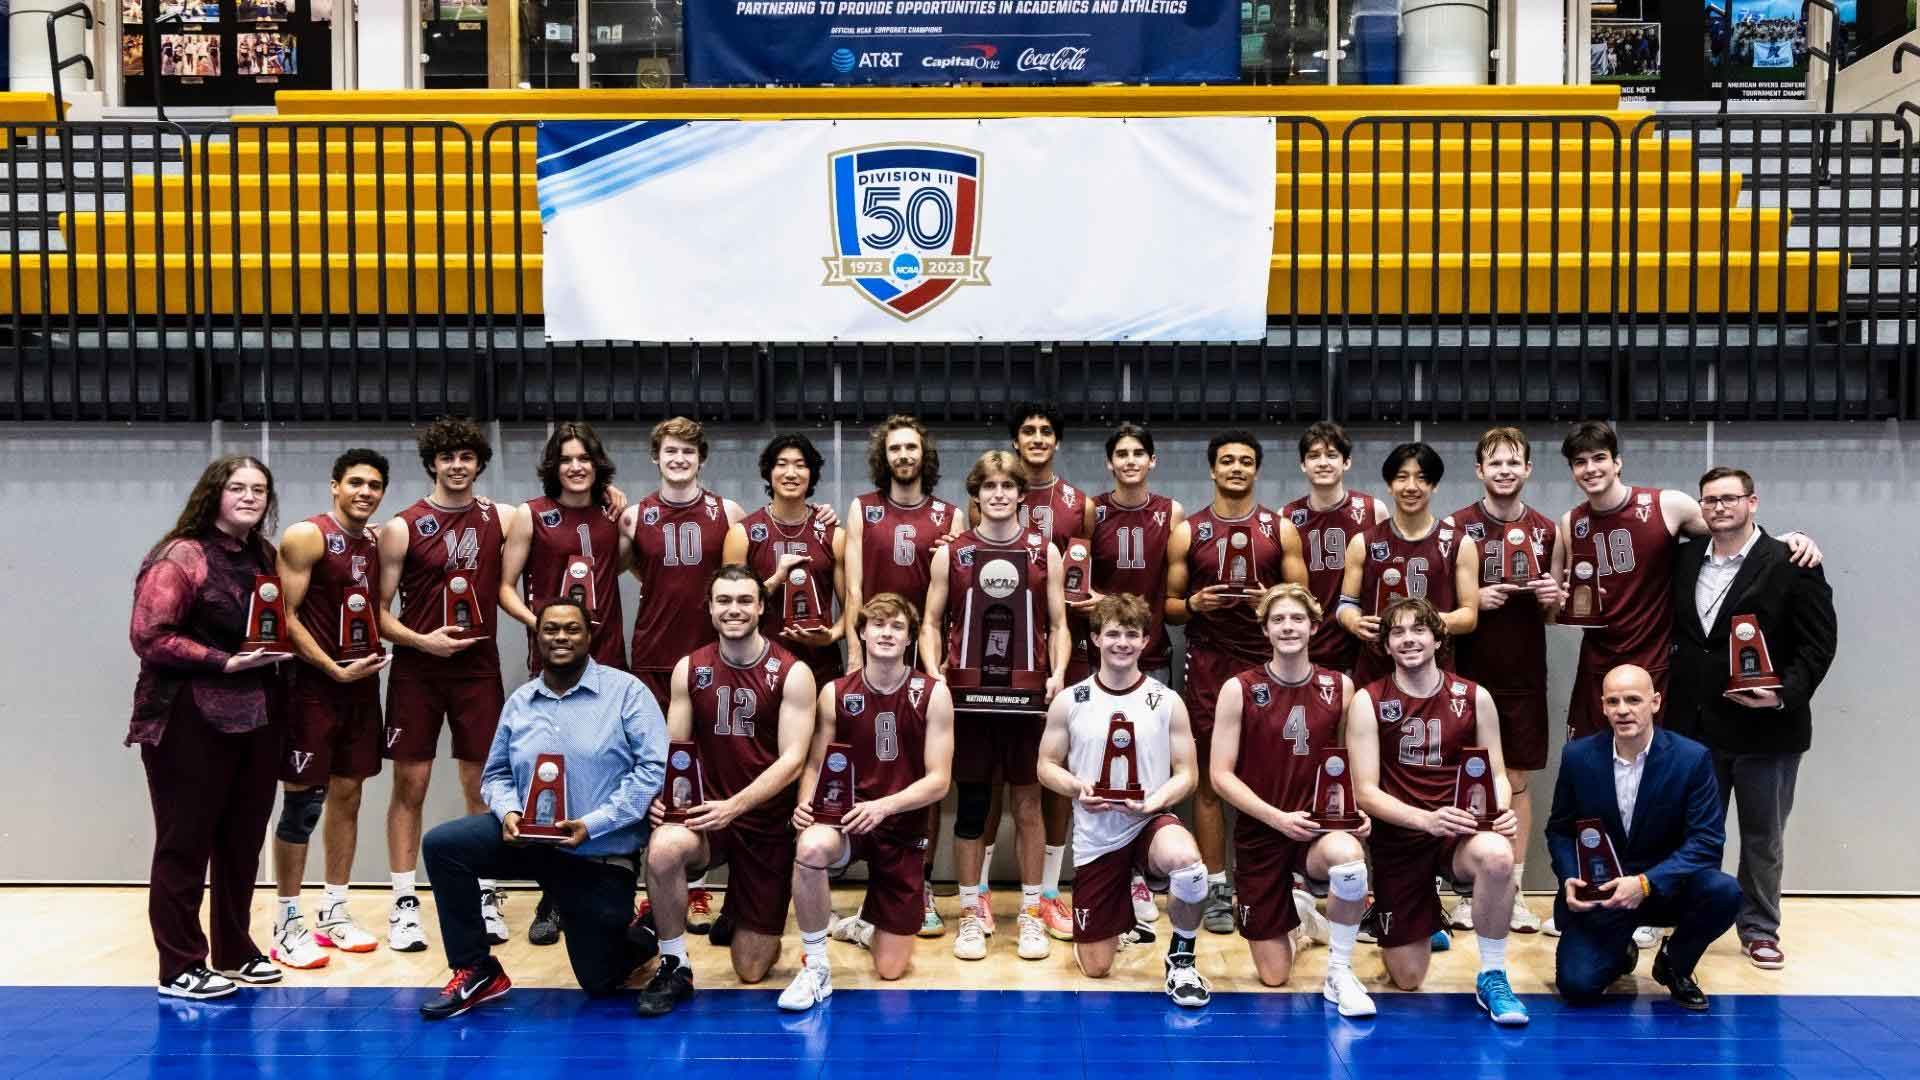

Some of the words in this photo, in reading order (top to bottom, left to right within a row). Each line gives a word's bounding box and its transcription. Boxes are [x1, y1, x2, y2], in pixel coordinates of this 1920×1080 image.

[736, 1, 816, 15] PARTNERING
[820, 1, 835, 15] TO
[838, 1, 893, 15] PROVIDE
[895, 1, 996, 15] OPPORTUNITIES
[998, 1, 1013, 15] IN
[1015, 0, 1090, 15] ACADEMICS
[1091, 0, 1118, 14] AND
[1120, 0, 1188, 14] ATHLETICS
[908, 26, 943, 34] CHAMPIONS
[858, 52, 903, 68] AT&T
[1016, 47, 1090, 71] Coca-Cola
[858, 171, 931, 186] DIVISION
[938, 174, 954, 185] III
[861, 186, 954, 250] 50
[851, 261, 883, 274] 1973
[896, 266, 919, 274] NCAA
[928, 261, 965, 273] 2023
[443, 527, 480, 570] 14
[662, 521, 703, 567] 10
[893, 524, 917, 567] 6
[1116, 526, 1146, 569] 11
[1307, 526, 1346, 572] 19
[1593, 528, 1636, 577] 18
[983, 577, 1018, 590] NCAA
[714, 685, 757, 738] 12
[965, 694, 995, 704] NATIONAL
[995, 694, 1030, 705] RUNNER-UP
[875, 711, 899, 762] 8
[1282, 705, 1310, 756] 4
[1399, 717, 1443, 768] 21
